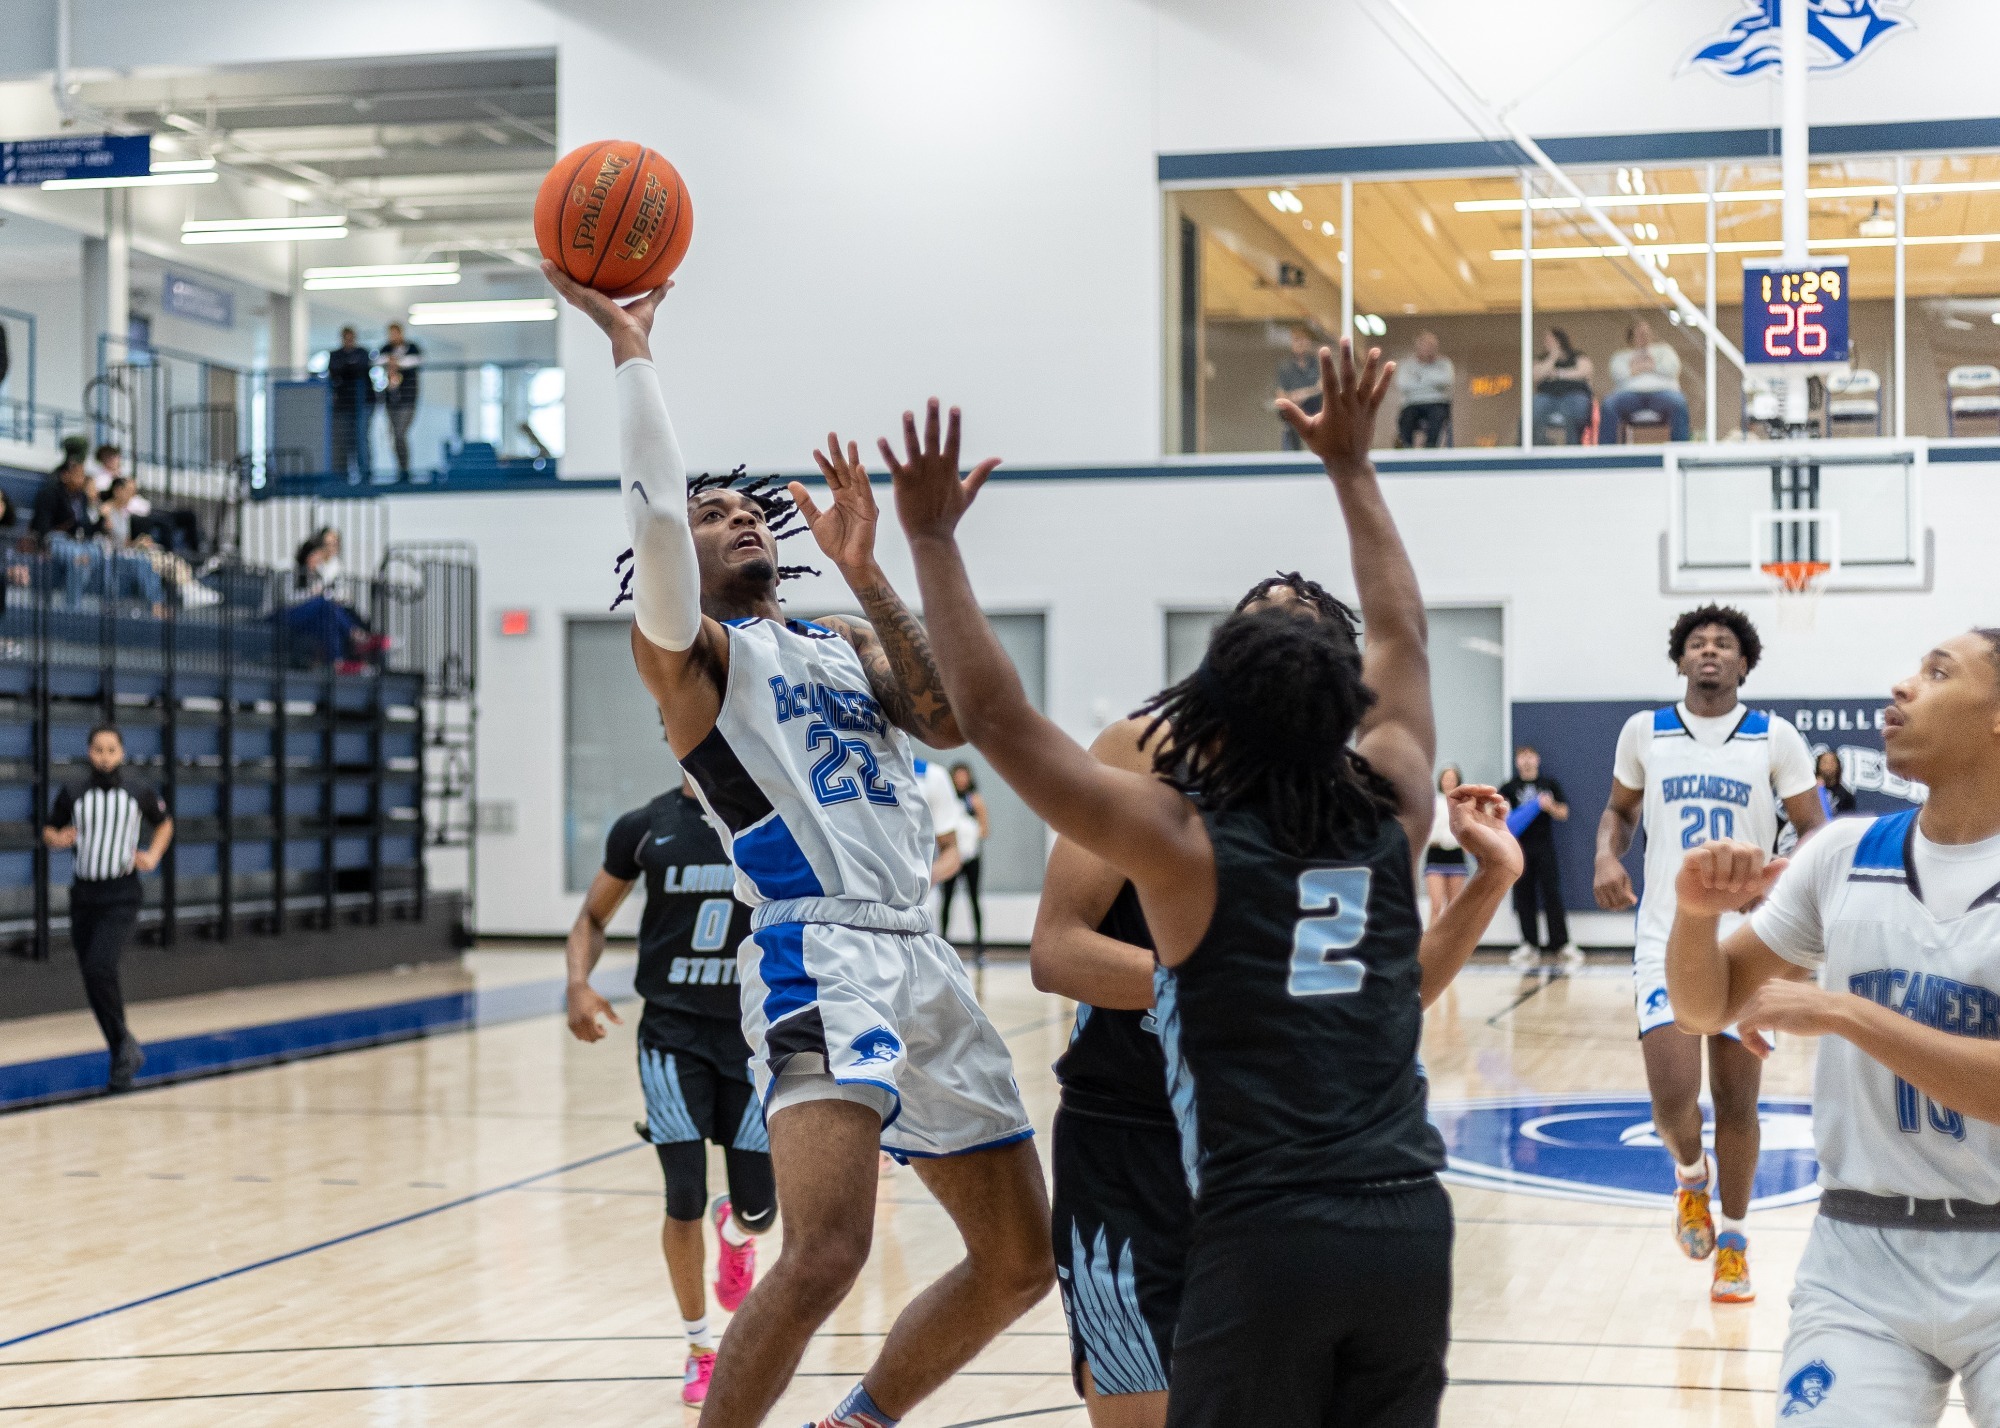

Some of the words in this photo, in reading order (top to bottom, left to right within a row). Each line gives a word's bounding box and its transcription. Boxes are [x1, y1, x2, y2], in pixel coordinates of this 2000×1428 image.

[571, 153, 632, 257] SPALDING
[614, 172, 661, 262] LEGACY
[1762, 270, 1841, 304] 11:29
[1763, 303, 1828, 357] 26
[806, 721, 900, 807] 22
[1662, 774, 1752, 808] BUCCANEERS
[1680, 805, 1734, 850] 20
[691, 898, 734, 952] 0
[1287, 867, 1373, 996] 2
[667, 956, 742, 985] STAT
